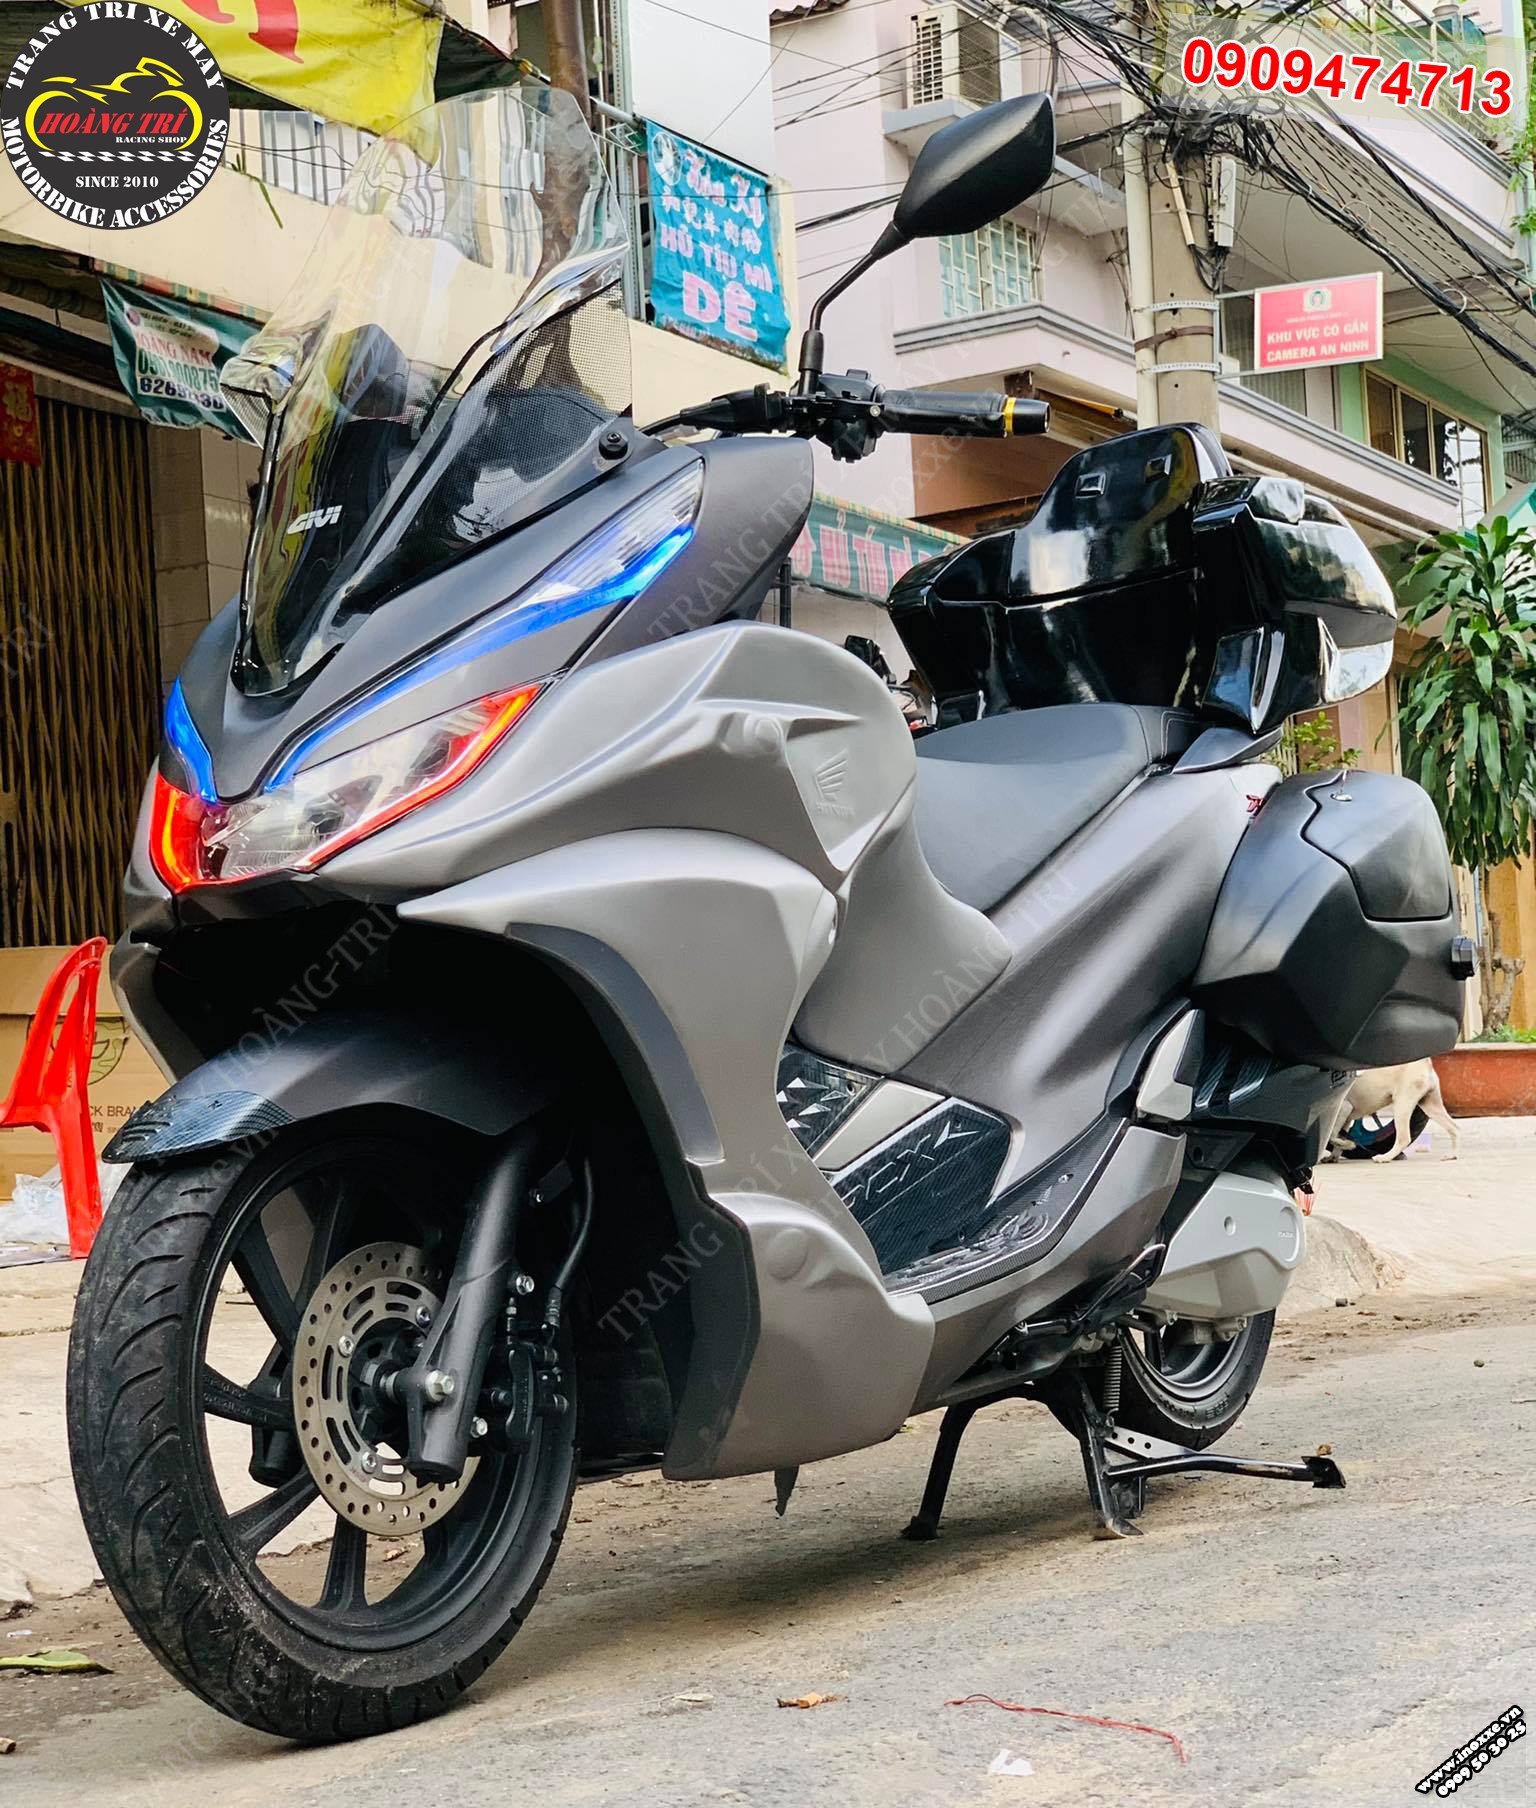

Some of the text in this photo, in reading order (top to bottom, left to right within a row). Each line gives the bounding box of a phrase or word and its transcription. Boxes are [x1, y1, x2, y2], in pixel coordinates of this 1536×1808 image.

[682, 270, 758, 342] DÊ
[1266, 339, 1369, 362] CAMERA AN NINH
[1267, 331, 1292, 345] KHU
[287, 505, 342, 534] GIVI
